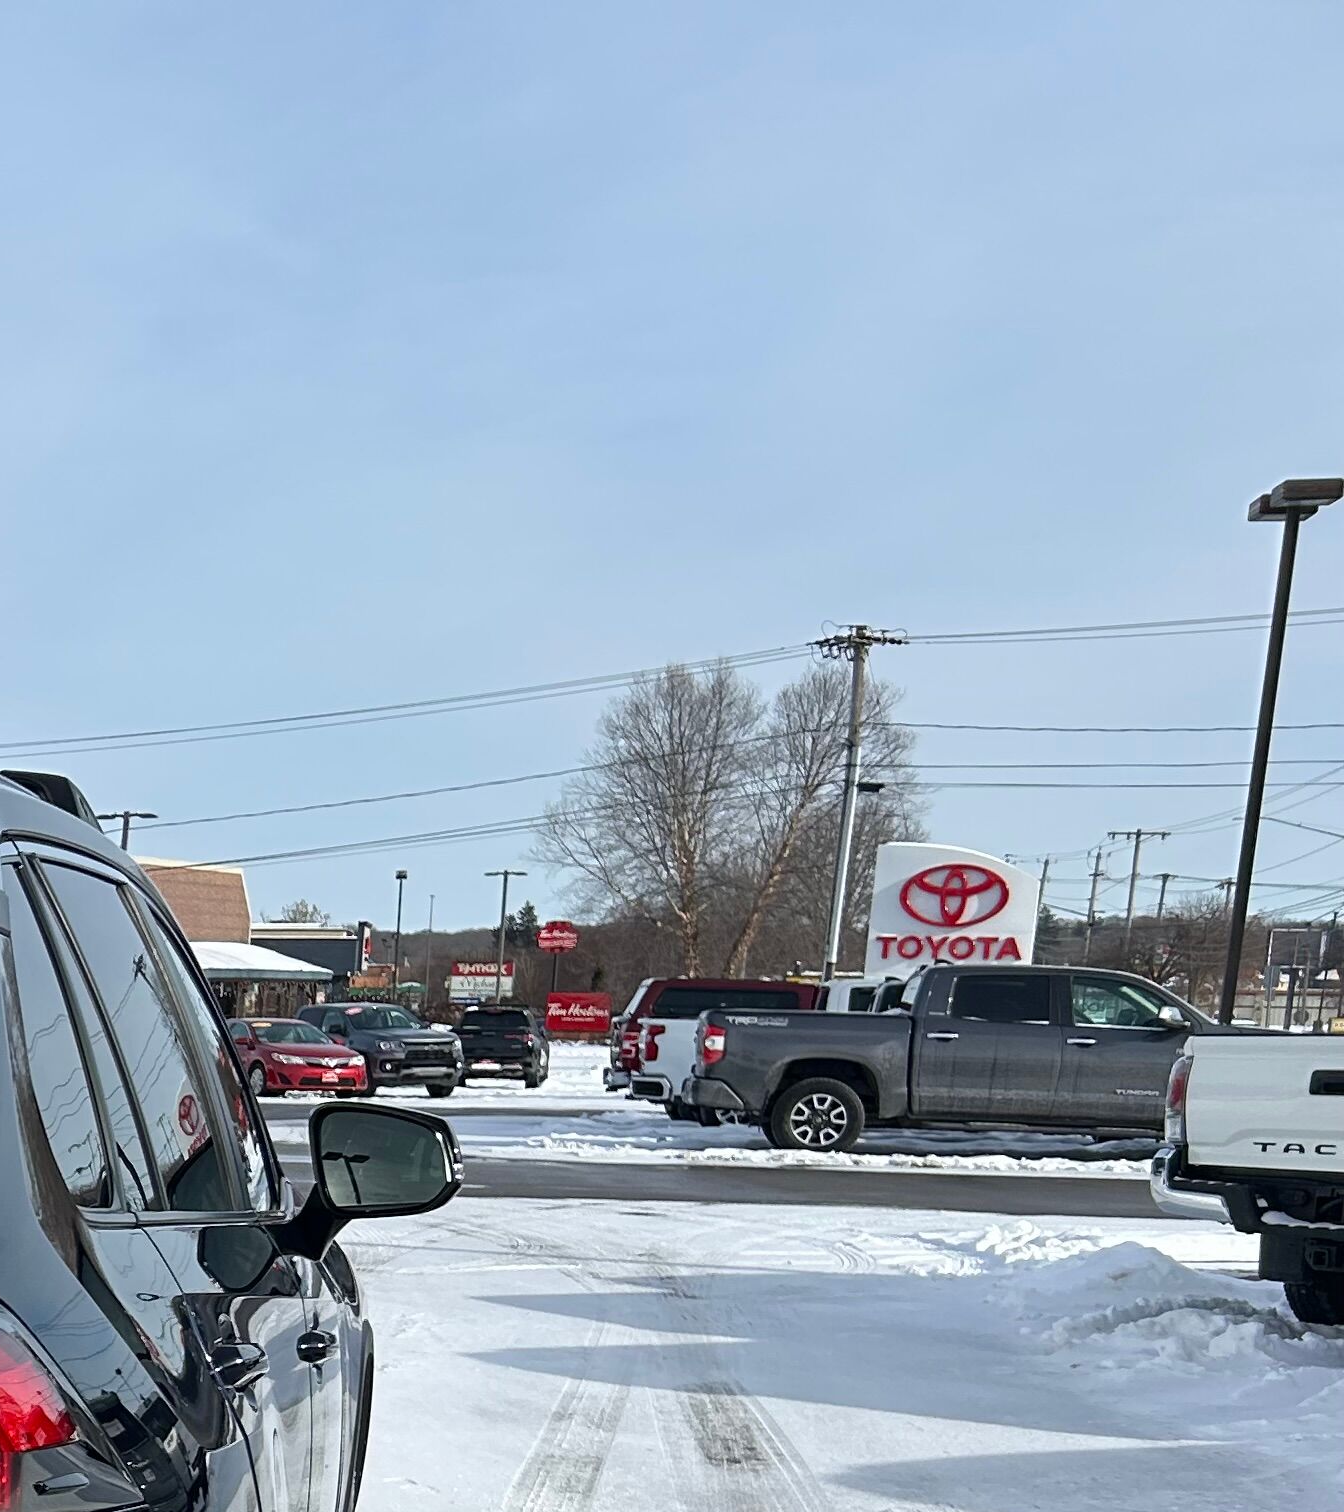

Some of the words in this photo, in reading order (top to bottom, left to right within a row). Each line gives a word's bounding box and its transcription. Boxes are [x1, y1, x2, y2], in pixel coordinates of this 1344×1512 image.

[876, 936, 1022, 960] TOYOTA
[1115, 1088, 1160, 1096] TUNDRA
[1253, 1142, 1337, 1155] TAC
